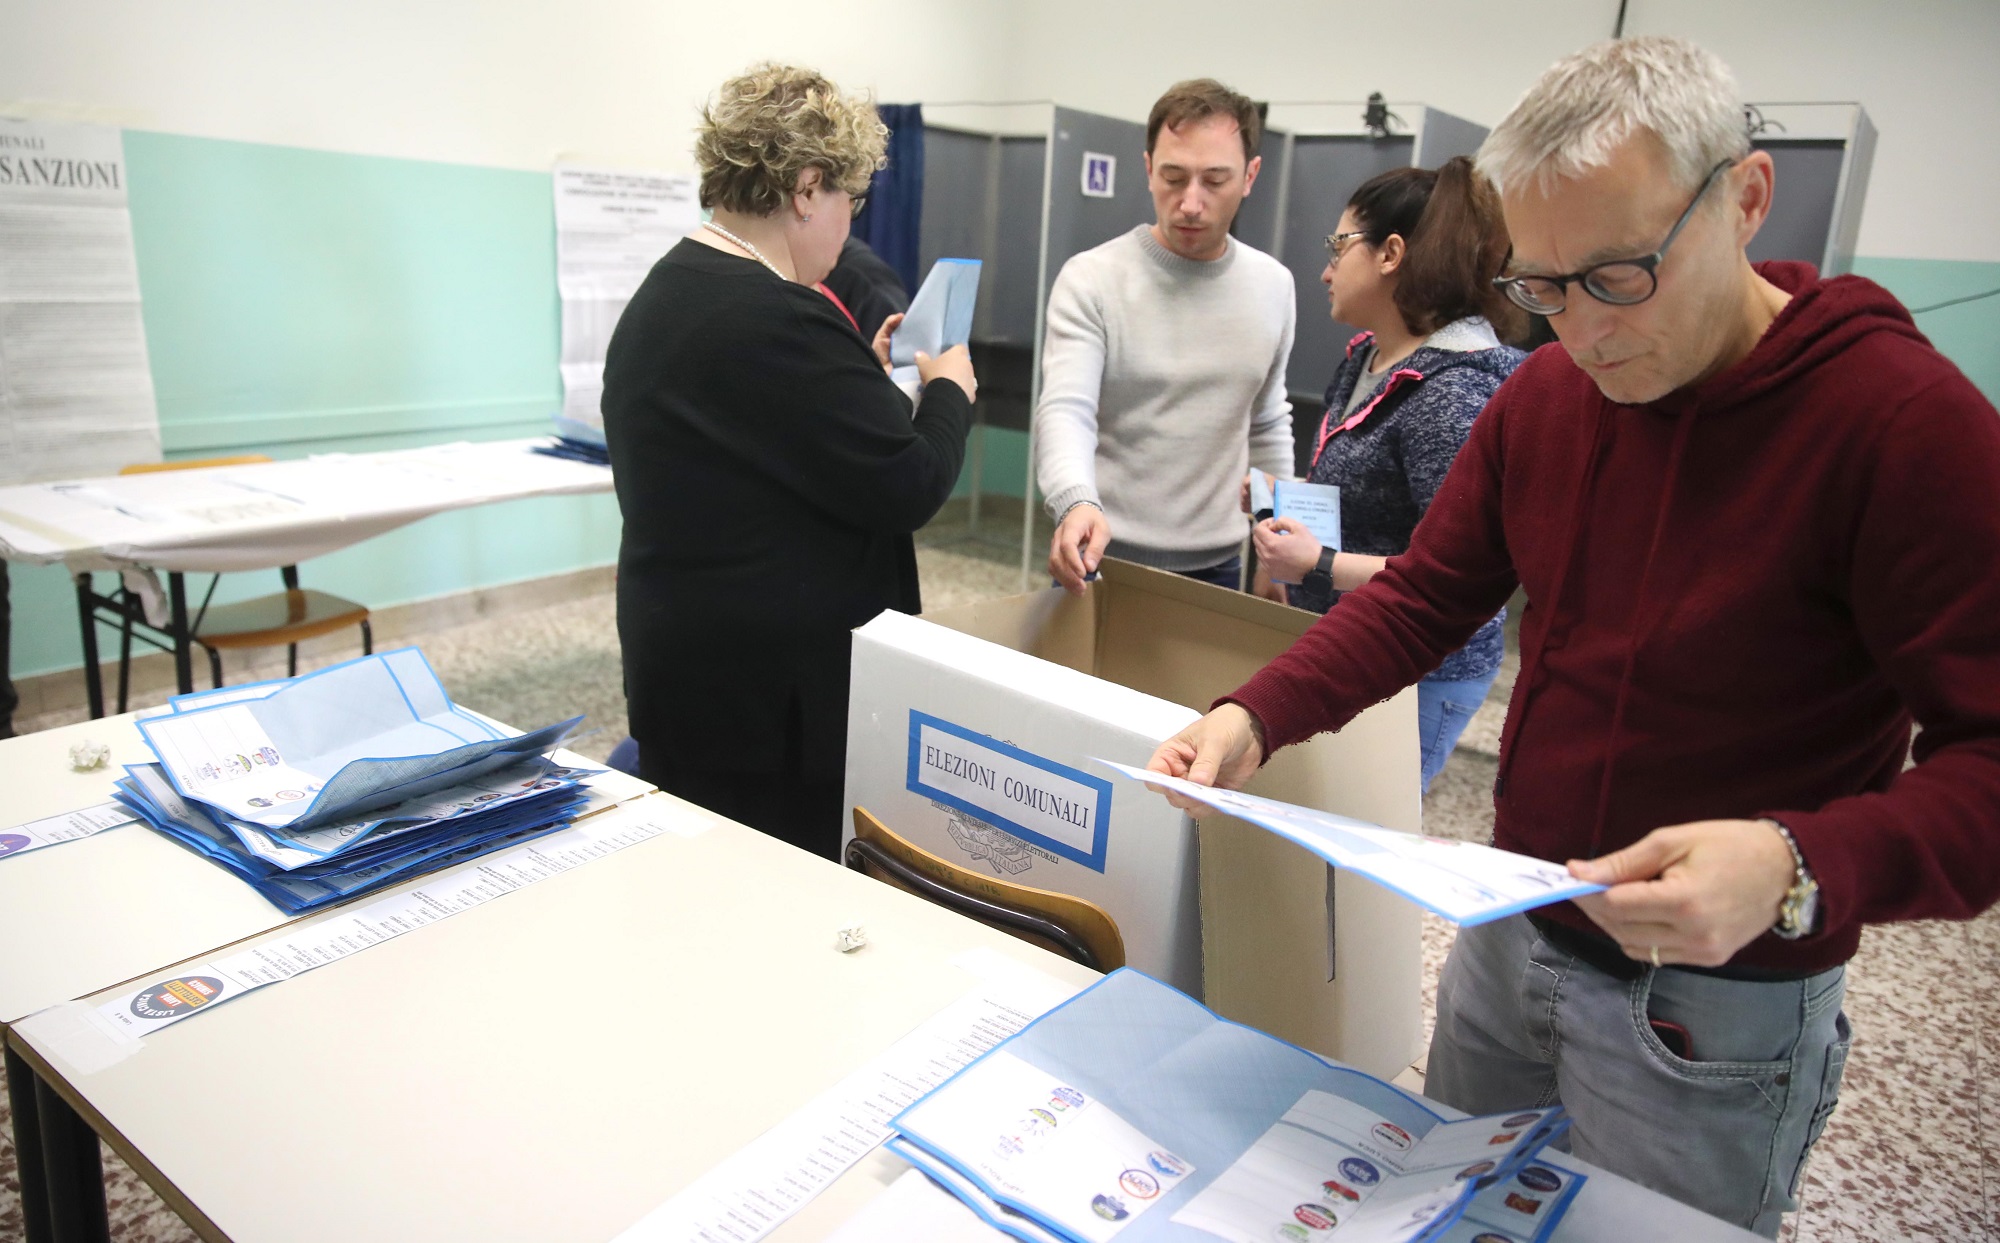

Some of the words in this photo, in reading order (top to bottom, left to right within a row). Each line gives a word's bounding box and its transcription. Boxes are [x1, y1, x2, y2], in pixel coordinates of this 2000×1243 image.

[0, 156, 120, 190] SANZIONI
[926, 745, 996, 791] ELEZIONI
[1004, 777, 1089, 830] COMUNALI
